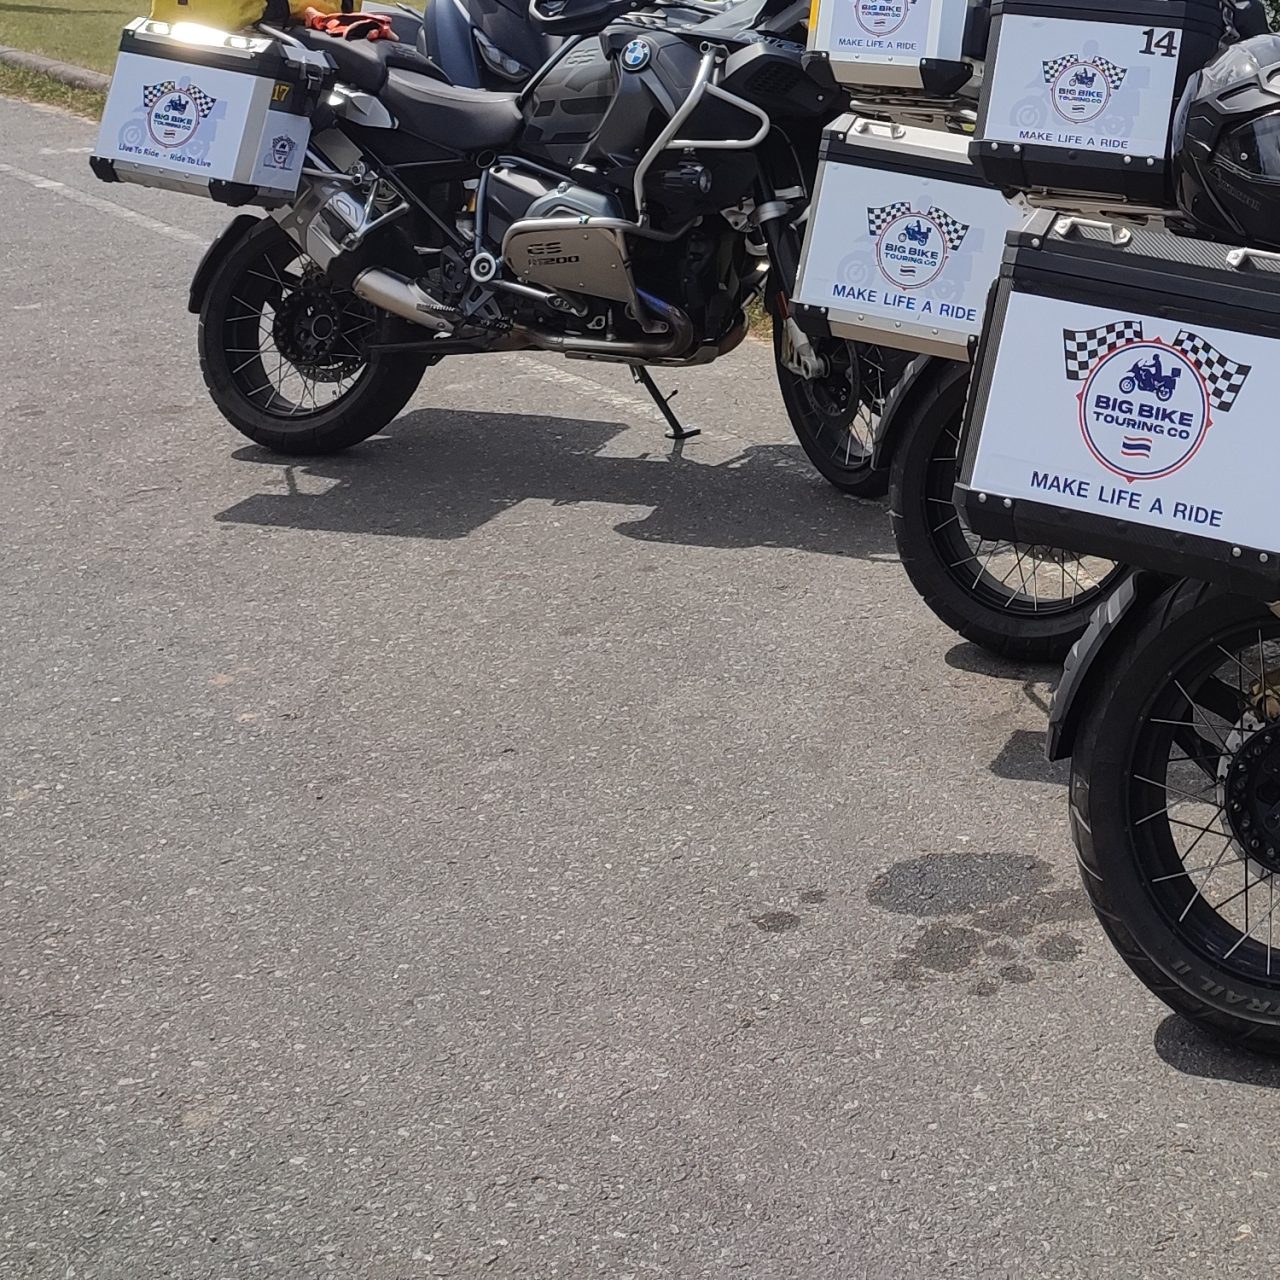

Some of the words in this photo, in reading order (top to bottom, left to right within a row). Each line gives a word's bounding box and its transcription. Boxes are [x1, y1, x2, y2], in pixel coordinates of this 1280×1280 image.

[838, 38, 863, 47] MAKE
[866, 40, 884, 48] LIFE
[887, 41, 893, 49] A
[896, 42, 917, 50] RIDE
[1138, 28, 1177, 58] 14
[566, 48, 600, 65] GS
[271, 84, 290, 101] 17
[1057, 94, 1090, 103] TOURING
[1058, 87, 1076, 96] BIG
[1078, 89, 1103, 99] BIKE
[153, 119, 181, 129] TOURING
[154, 112, 170, 121] BIG
[171, 114, 193, 126] BIKE
[1018, 130, 1053, 142] MAKE
[1057, 133, 1083, 145] LIFE
[1086, 136, 1095, 146] A
[1100, 138, 1129, 149] RIDE
[118, 143, 133, 153] Live
[134, 146, 142, 154] To
[143, 147, 160, 158] Ride
[169, 153, 186, 163] Ride
[187, 156, 195, 164] To
[195, 158, 212, 168] Live
[527, 241, 563, 255] GS
[884, 242, 907, 254] BIG
[908, 246, 939, 260] BIKE
[883, 251, 924, 265] TOURING
[924, 259, 937, 267] CO
[832, 283, 878, 303] MAKE
[883, 292, 917, 311] LIFE
[921, 300, 932, 314] A
[939, 303, 977, 322] RIDE
[1094, 394, 1134, 416] BIG
[1137, 402, 1194, 428] BIKE
[1092, 410, 1165, 436] TOURING
[1166, 426, 1191, 440] CO
[1030, 470, 1091, 499] MAKE
[1097, 485, 1143, 510] LIFE
[1149, 497, 1164, 515] A
[1173, 501, 1224, 528] RIDE
